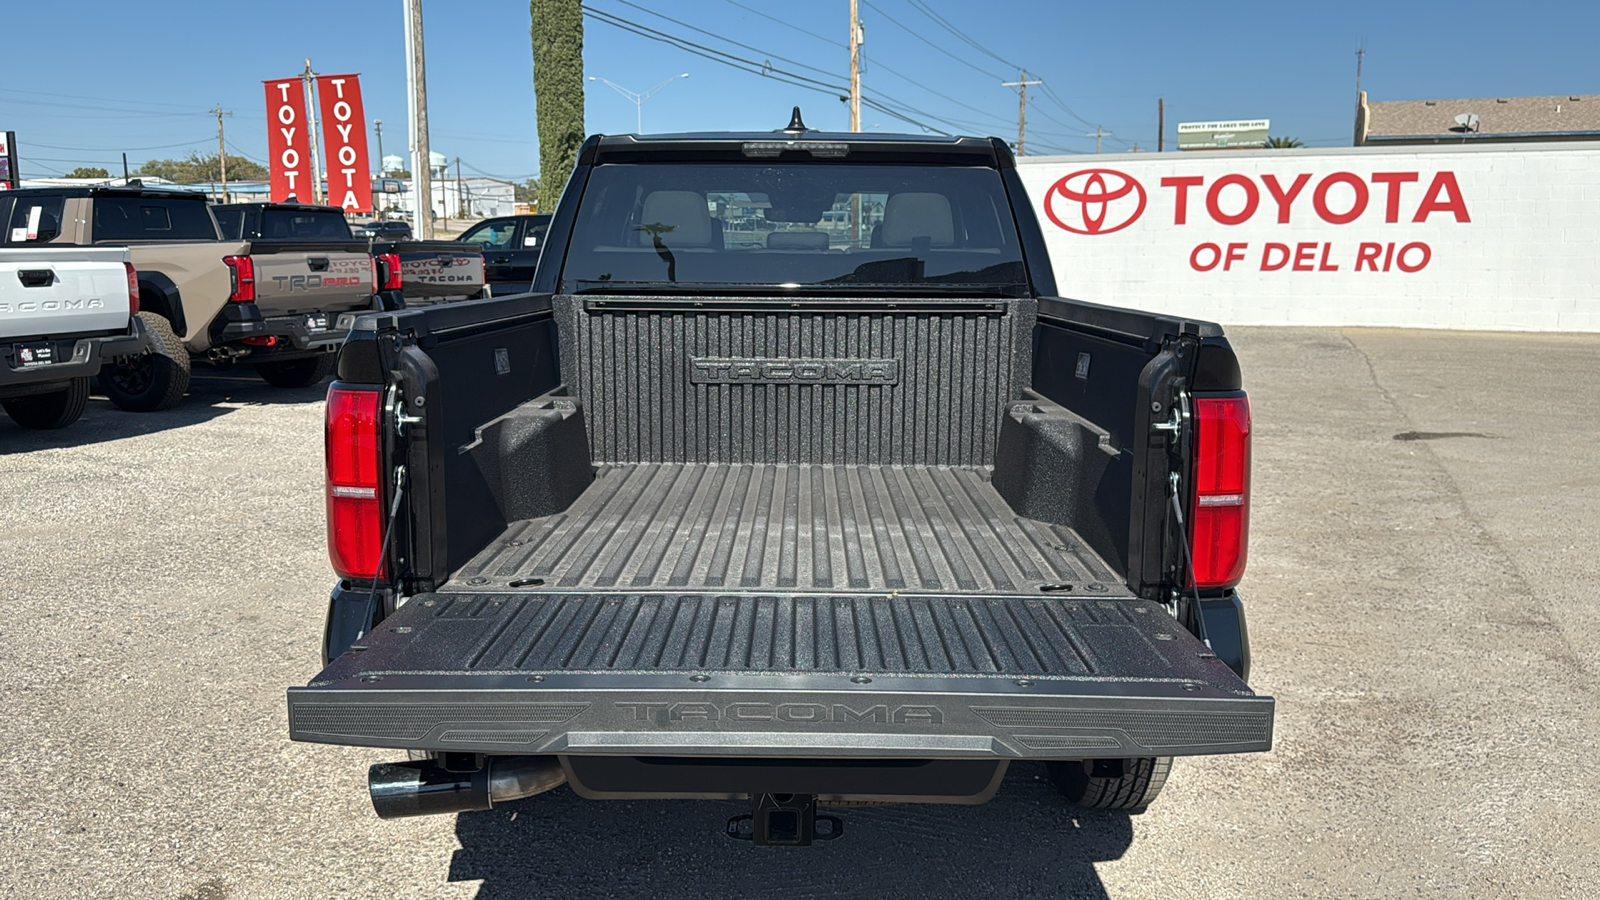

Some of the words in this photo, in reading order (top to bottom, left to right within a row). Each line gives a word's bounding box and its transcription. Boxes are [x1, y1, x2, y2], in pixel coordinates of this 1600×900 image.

[331, 78, 360, 209] TOYOTA
[1160, 171, 1471, 225] TOYOTA
[1189, 242, 1248, 272] OF
[1259, 242, 1340, 271] DEL
[1354, 241, 1432, 273] RIO
[272, 274, 322, 293] TRD
[322, 276, 360, 287] PRO
[418, 275, 473, 283] TACOMA
[0, 298, 105, 313] ACOMA
[694, 361, 895, 380] TACOMA
[613, 701, 944, 724] TACOMA
